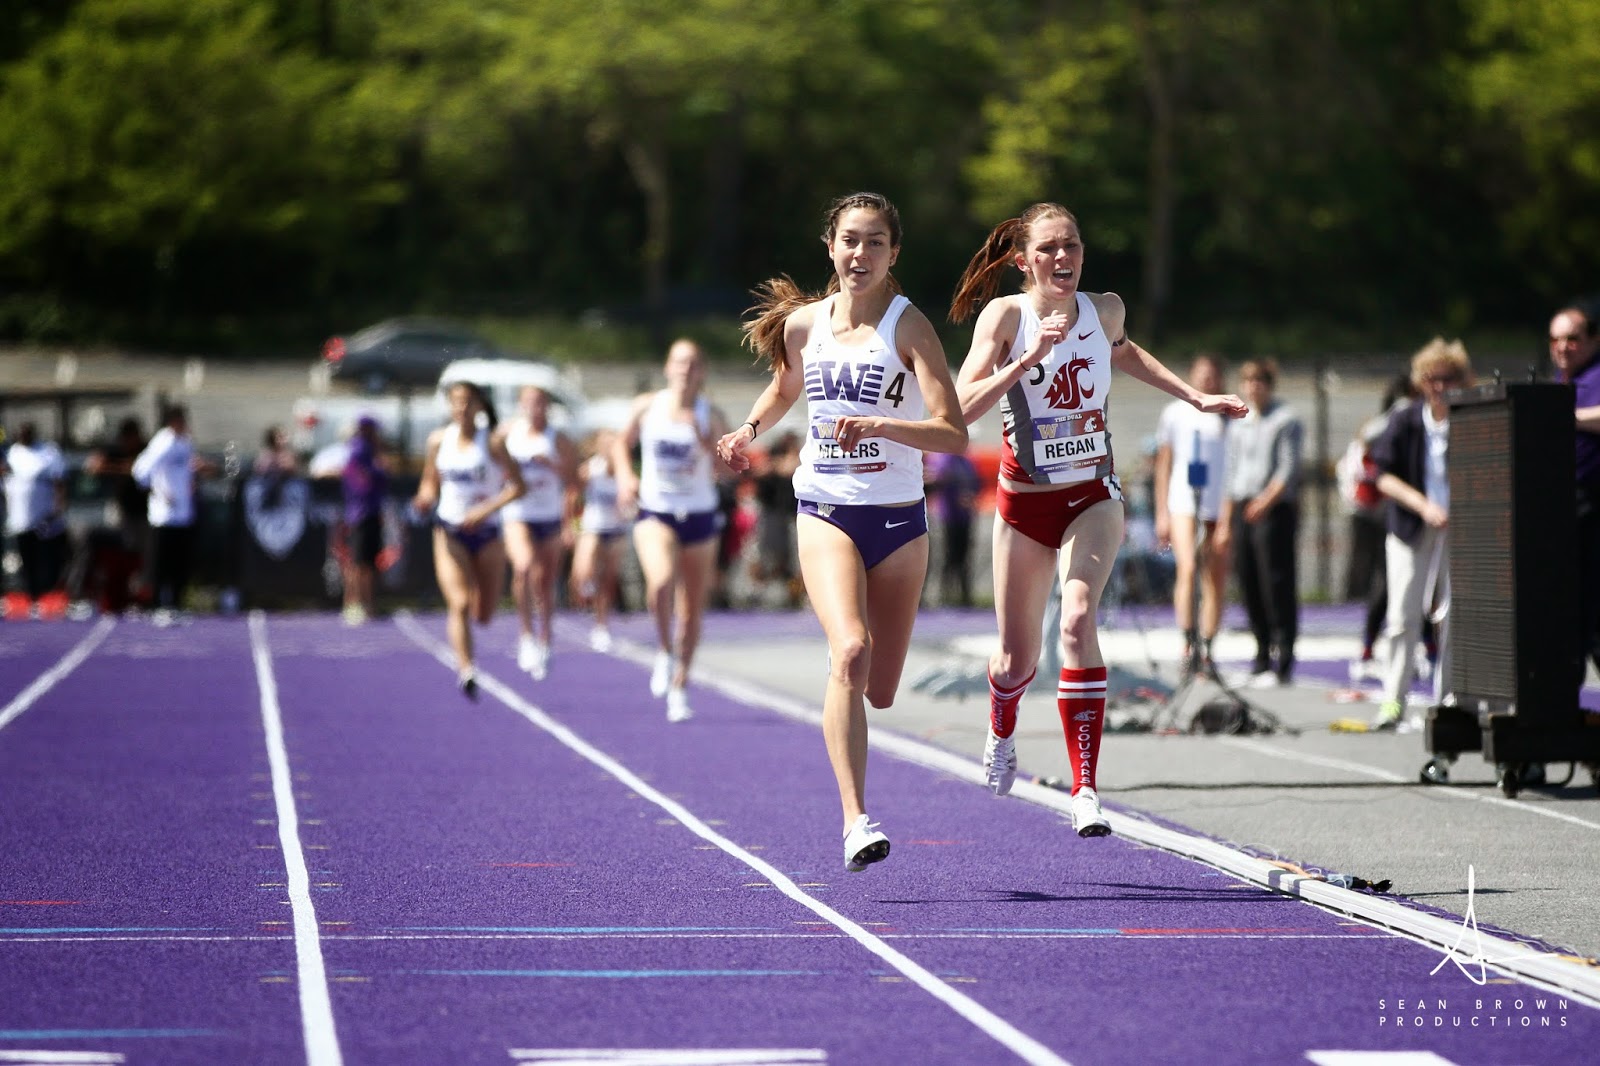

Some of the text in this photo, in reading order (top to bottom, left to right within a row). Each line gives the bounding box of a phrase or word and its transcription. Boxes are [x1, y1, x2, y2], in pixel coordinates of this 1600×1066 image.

[884, 371, 906, 409] 4
[1067, 413, 1083, 421] DUAL
[1037, 423, 1059, 440] W
[1045, 437, 1096, 460] REGAN
[817, 502, 835, 518] W
[1078, 724, 1092, 784] COUGARS
